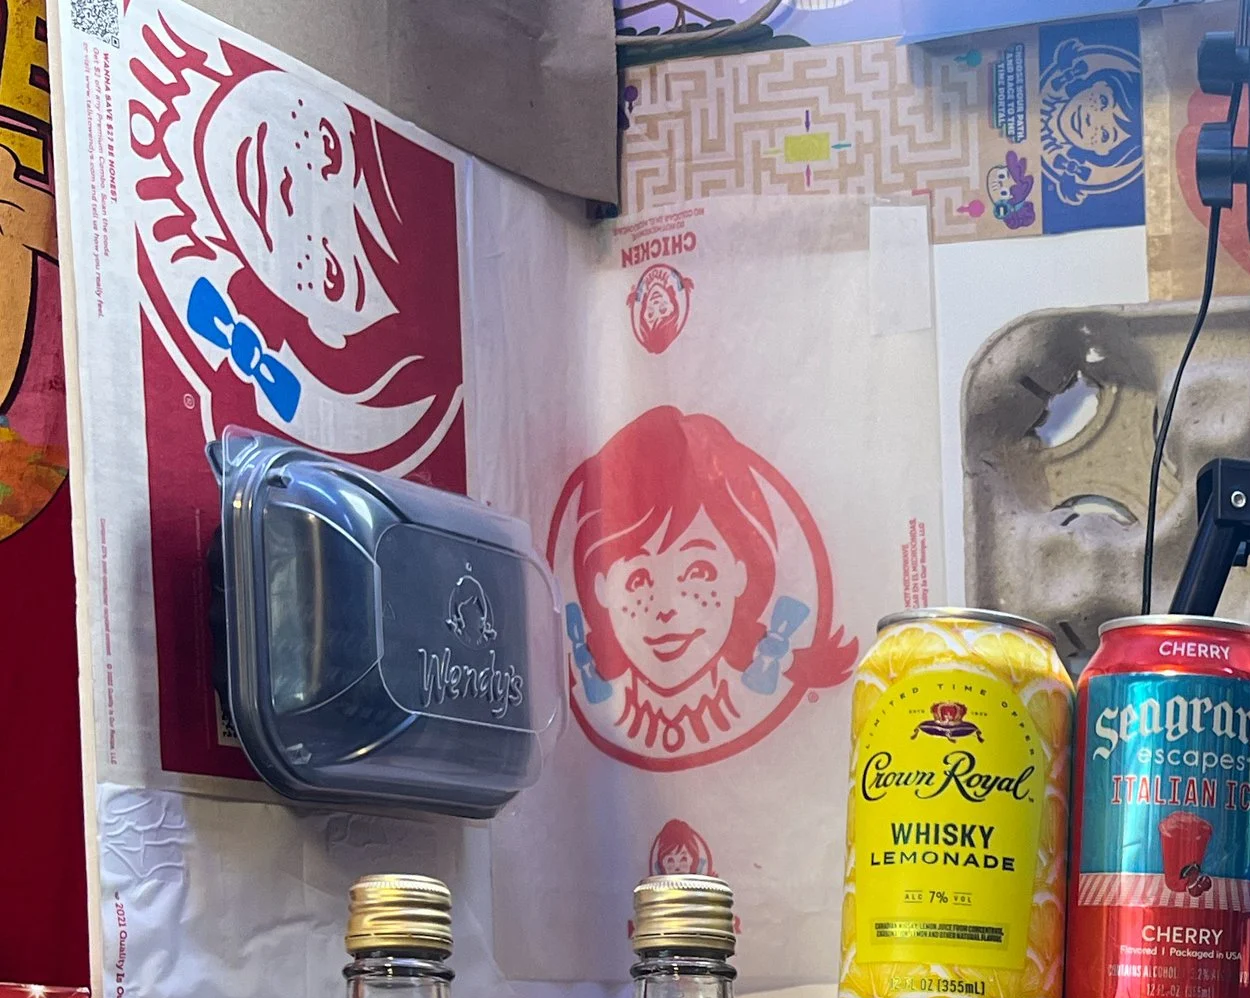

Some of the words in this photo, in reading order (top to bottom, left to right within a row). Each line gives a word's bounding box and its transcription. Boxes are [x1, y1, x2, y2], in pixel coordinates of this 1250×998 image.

[621, 231, 697, 268] CHICKEN
[1159, 641, 1230, 660] CHERRY
[417, 648, 524, 719] Wendy's
[937, 683, 988, 697] TIME
[1136, 746, 1247, 772] escapes
[861, 751, 934, 801] Crown
[916, 750, 1032, 802] Royal
[1111, 774, 1217, 807] ITALIAN
[890, 822, 996, 850] WHISKY
[870, 851, 1016, 872] LEMONADE
[928, 890, 949, 904] 7%
[115, 902, 127, 927] 2021
[1141, 924, 1224, 946] CHERRY
[115, 930, 128, 969] Quality
